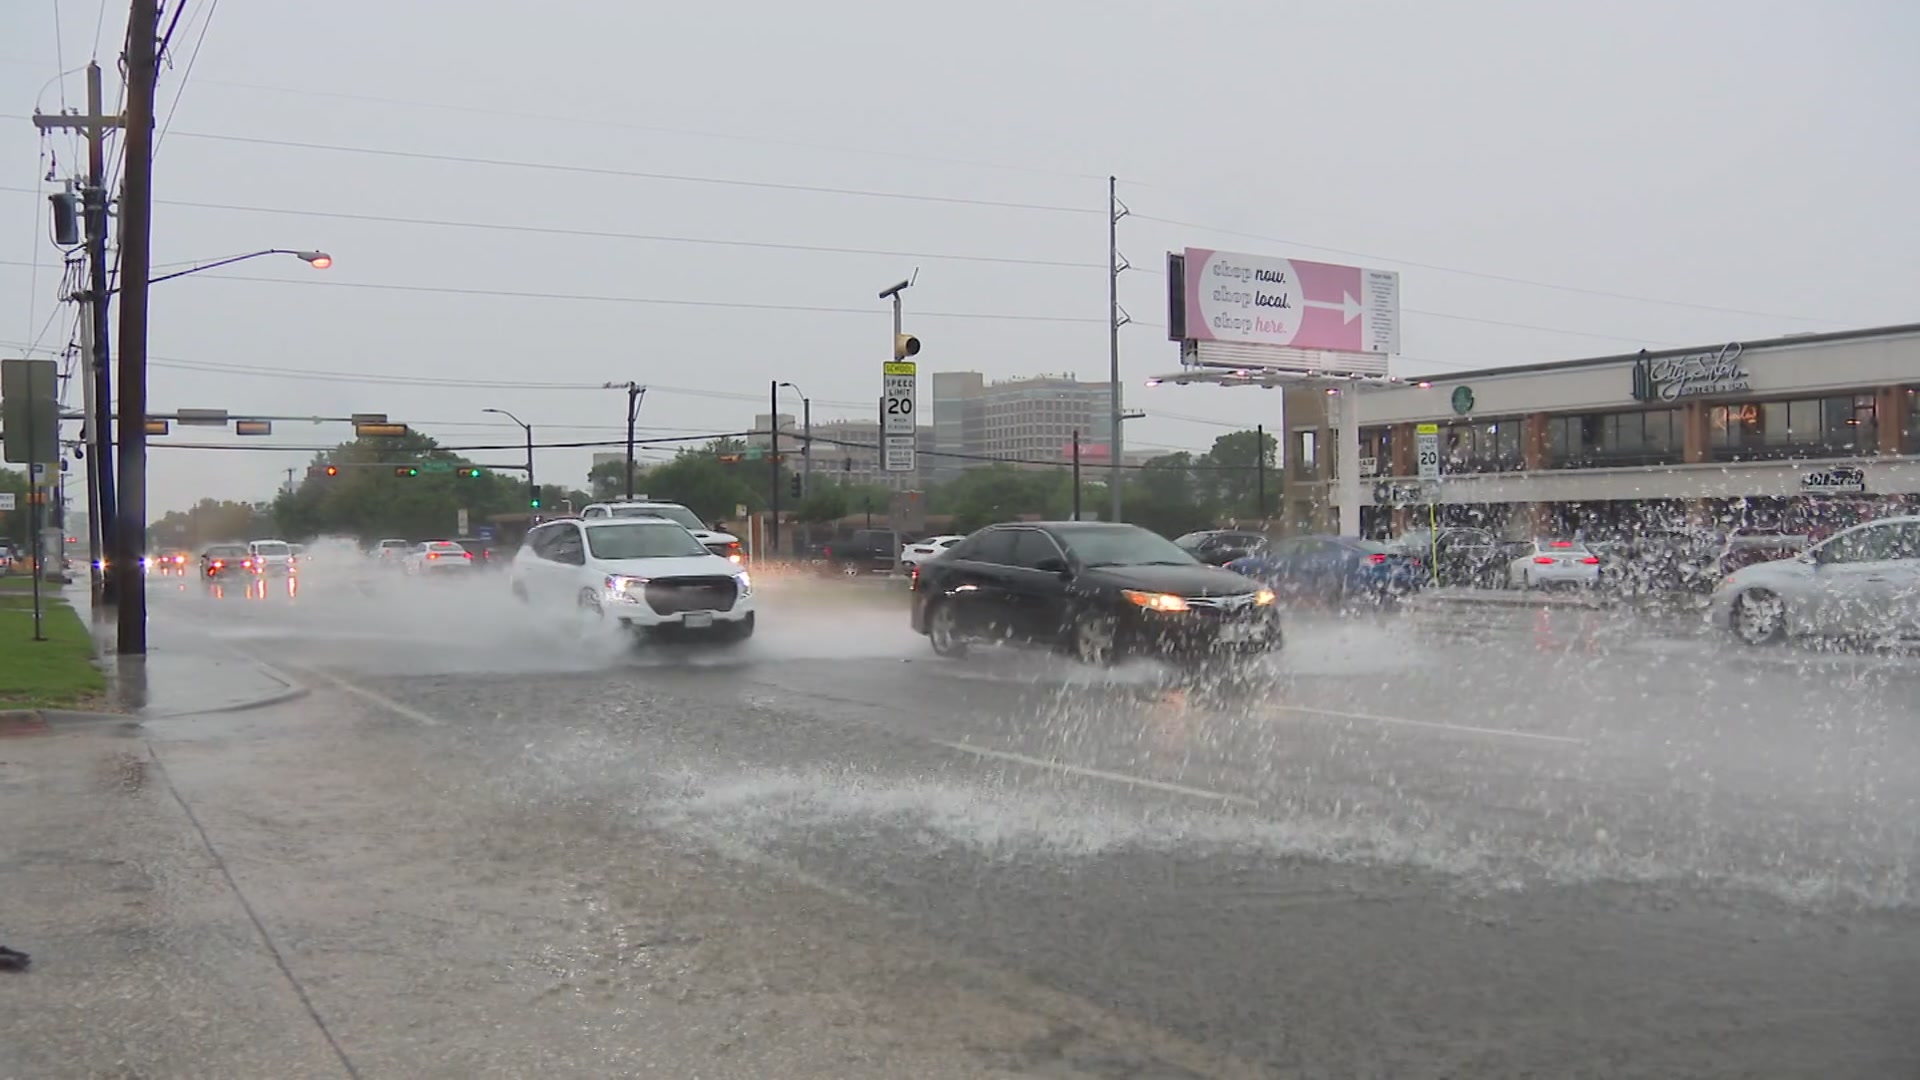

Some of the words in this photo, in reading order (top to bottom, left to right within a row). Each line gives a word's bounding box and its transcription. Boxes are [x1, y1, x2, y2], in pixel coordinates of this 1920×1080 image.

[1213, 260, 1251, 283] shop
[1255, 269, 1286, 284] now.
[1213, 285, 1251, 308] shop
[1255, 290, 1292, 308] local.
[1213, 311, 1252, 334] shop
[1255, 316, 1287, 334] here.
[886, 379, 915, 388] SPEED
[1650, 356, 1687, 402] City
[889, 388, 910, 397] LIMIT
[888, 398, 912, 414] 20
[1420, 451, 1437, 465] 20
